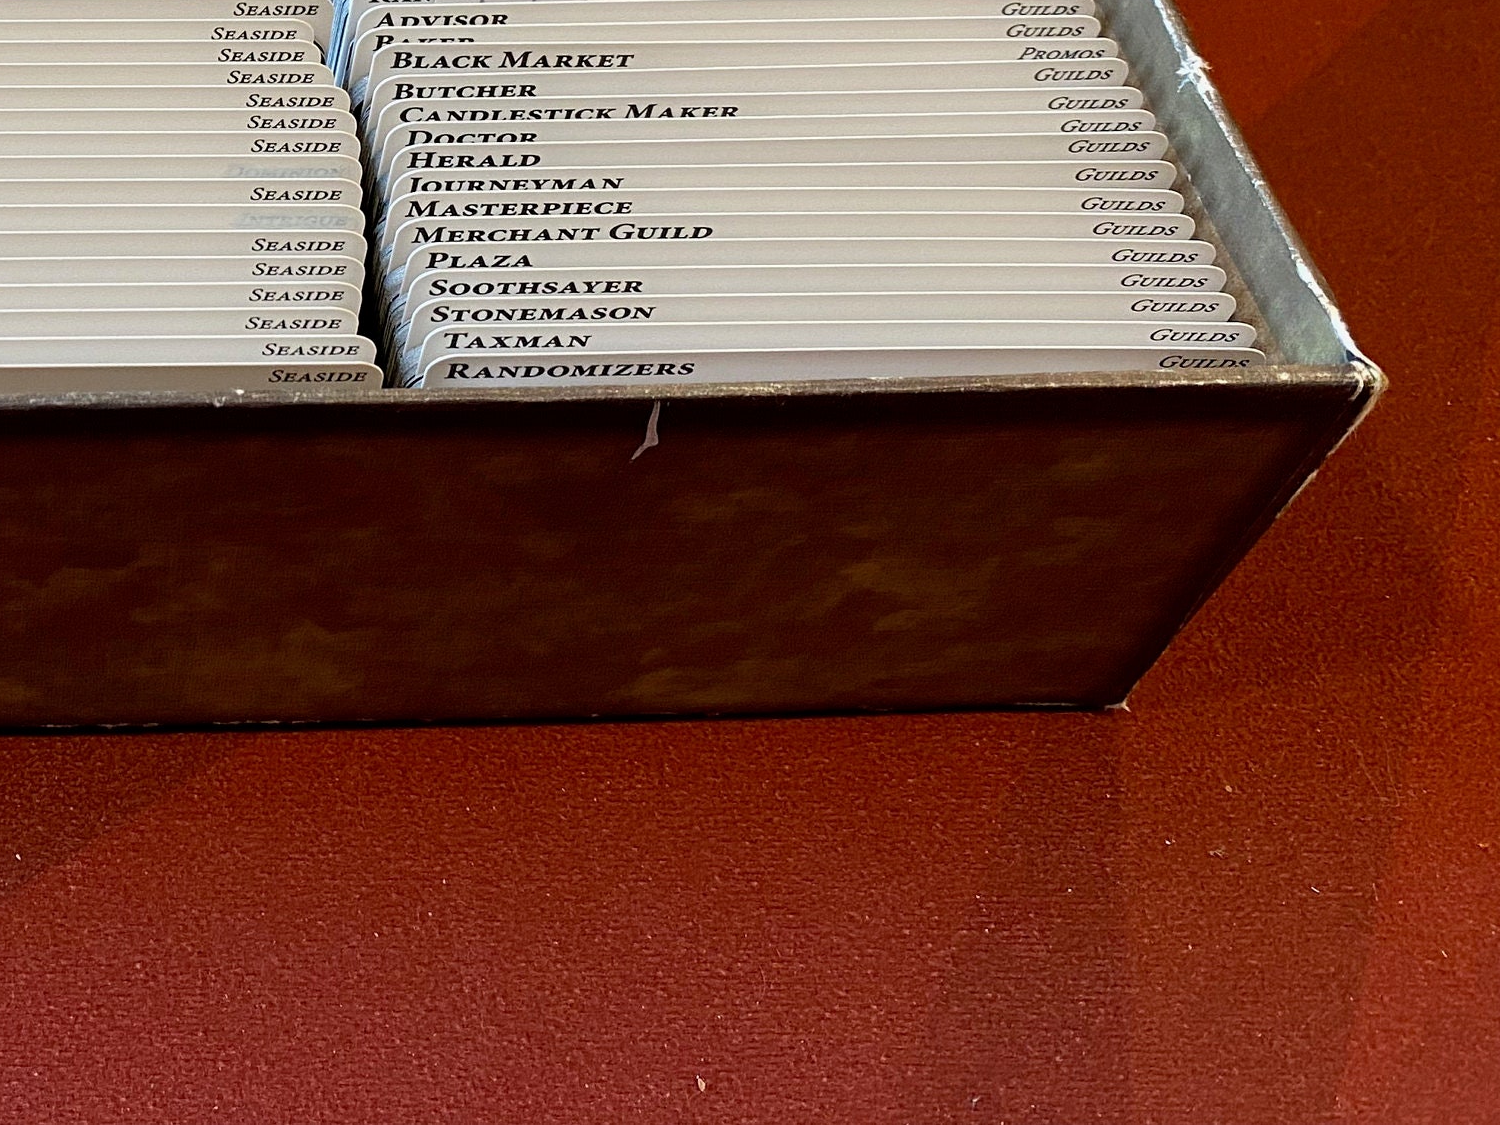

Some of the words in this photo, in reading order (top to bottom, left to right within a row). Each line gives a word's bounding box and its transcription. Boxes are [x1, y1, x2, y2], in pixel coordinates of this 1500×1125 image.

[233, 3, 319, 17] SEASIDE
[1001, 3, 1079, 16] GUILDS
[374, 13, 508, 28] ADVISOR
[211, 27, 298, 40] SEASIDE
[1006, 24, 1084, 37] GUILDS
[217, 48, 304, 63] SEASIDE
[390, 51, 493, 69] BLACK
[498, 51, 634, 68] MARKET
[1017, 47, 1104, 60] PROMOS
[226, 71, 315, 85] SEASIDE
[1034, 68, 1113, 81] GUILDS
[392, 83, 537, 100] BUTCHER
[245, 94, 335, 108] SEASIDE
[1048, 96, 1128, 110] GUILDS
[399, 107, 616, 123] CANDLESTICK
[625, 104, 739, 119] MAKER
[247, 115, 337, 130] SEASIDE
[1060, 120, 1141, 132] GUILDS
[405, 131, 538, 146] DOCTOR
[250, 139, 342, 154] SEASIDE
[1068, 140, 1150, 153] GUILDS
[407, 152, 541, 168] HERALD
[1075, 168, 1158, 181] GUILDS
[411, 178, 624, 192] JOURNEYMAN
[250, 187, 342, 202] SEASIDE
[405, 200, 632, 217] MASTERPIECE
[1080, 197, 1165, 211] GUILDS
[411, 227, 600, 243] MERCHANT
[609, 224, 713, 240] GUILD
[1092, 222, 1178, 235] GUILDS
[251, 238, 346, 252] SEASIDE
[425, 252, 532, 269] PLAZA
[1111, 249, 1198, 262] GUILDS
[252, 263, 347, 276] SEASIDE
[1120, 274, 1207, 287] GUILDS
[249, 288, 345, 302] SEASIDE
[428, 280, 643, 296] SOOTHSAYER
[1130, 299, 1219, 312] GUILDS
[430, 306, 656, 322] STONEMASON
[245, 316, 342, 331] SEASIDE
[444, 333, 591, 349] TAXMAN
[1149, 329, 1239, 342] GUILDS
[262, 342, 360, 357] SEASIDE
[1158, 355, 1249, 368] GUILDS
[268, 370, 368, 384] SEASIDE
[444, 363, 695, 379] RANDOMIZERS
